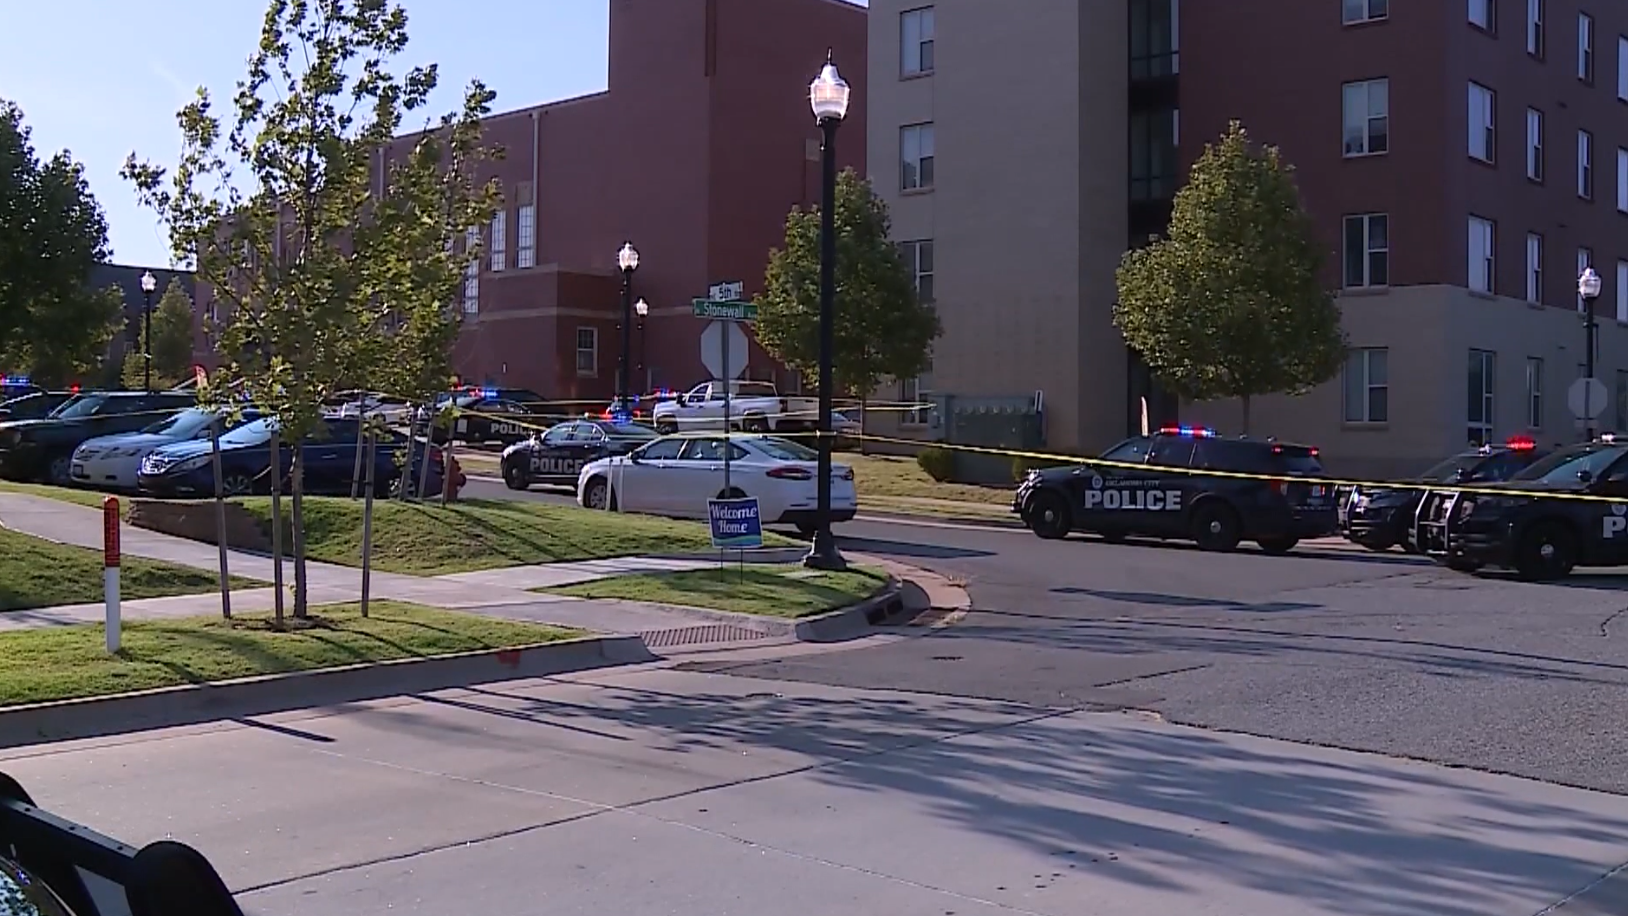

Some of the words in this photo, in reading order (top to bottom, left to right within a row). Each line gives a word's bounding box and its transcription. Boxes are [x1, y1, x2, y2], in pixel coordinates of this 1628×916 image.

[719, 286, 732, 299] 5th
[703, 302, 745, 318] Stonewall
[1084, 489, 1181, 510] POLICE
[710, 503, 757, 519] Welcome
[718, 520, 748, 533] Home
